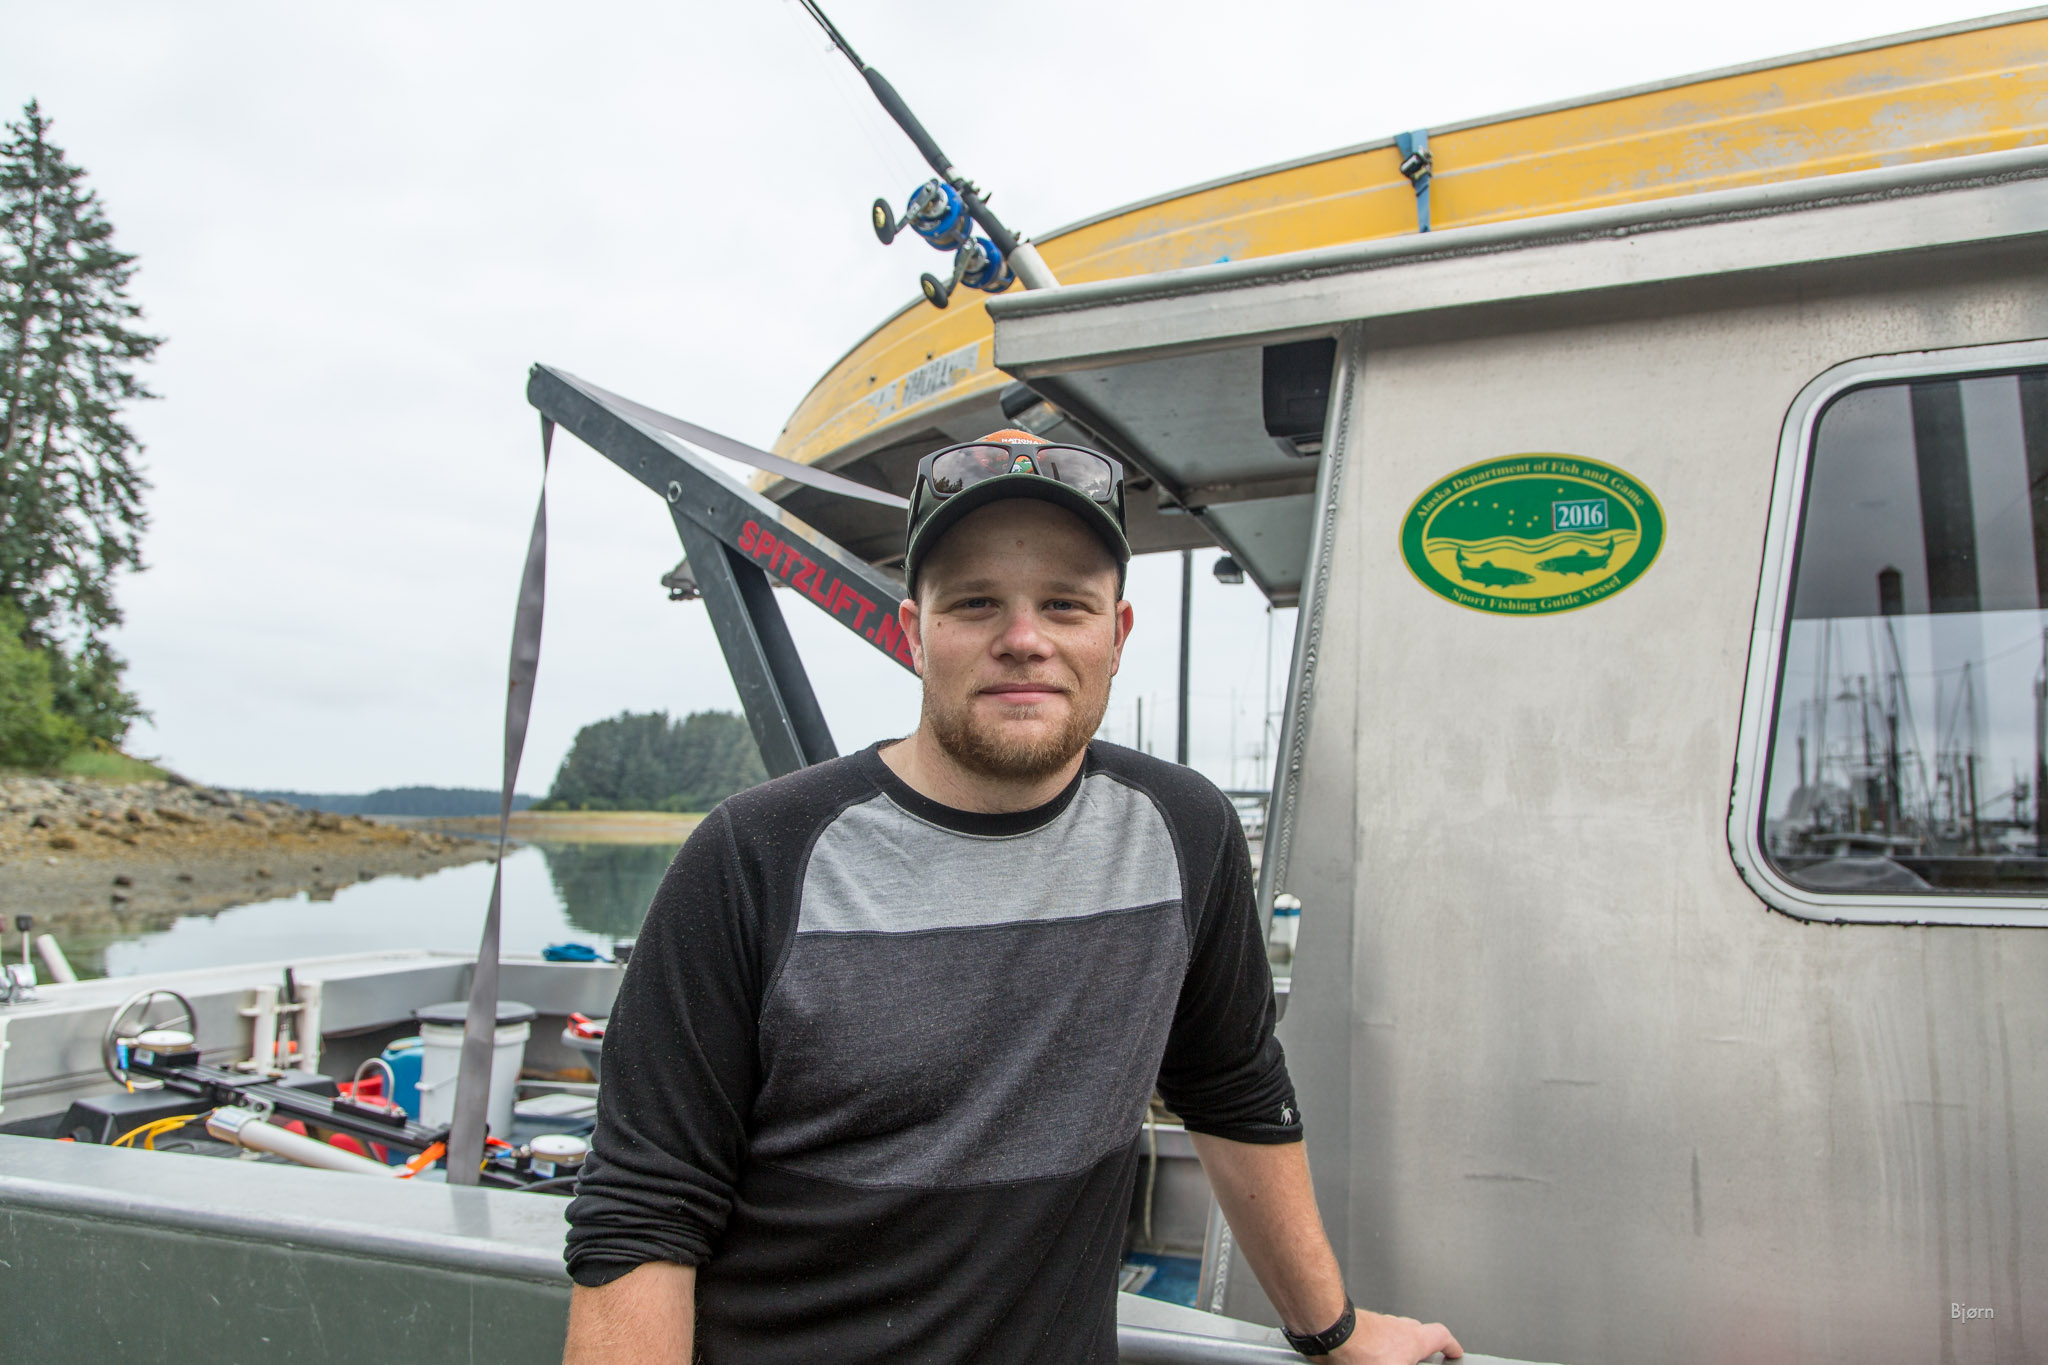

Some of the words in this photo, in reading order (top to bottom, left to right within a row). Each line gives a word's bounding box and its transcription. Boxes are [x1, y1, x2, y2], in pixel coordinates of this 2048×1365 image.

[1417, 487, 1452, 520] Alaska
[1452, 463, 1530, 490] Department
[1533, 461, 1549, 472] of
[1551, 461, 1580, 474] Fish
[1582, 468, 1610, 483] and
[1610, 477, 1644, 507] Game
[1557, 503, 1603, 528] 2016
[1453, 588, 1486, 607] Sport
[1489, 598, 1537, 612] Fishing
[1540, 594, 1580, 609] Guide
[1582, 575, 1621, 599] Vessel
